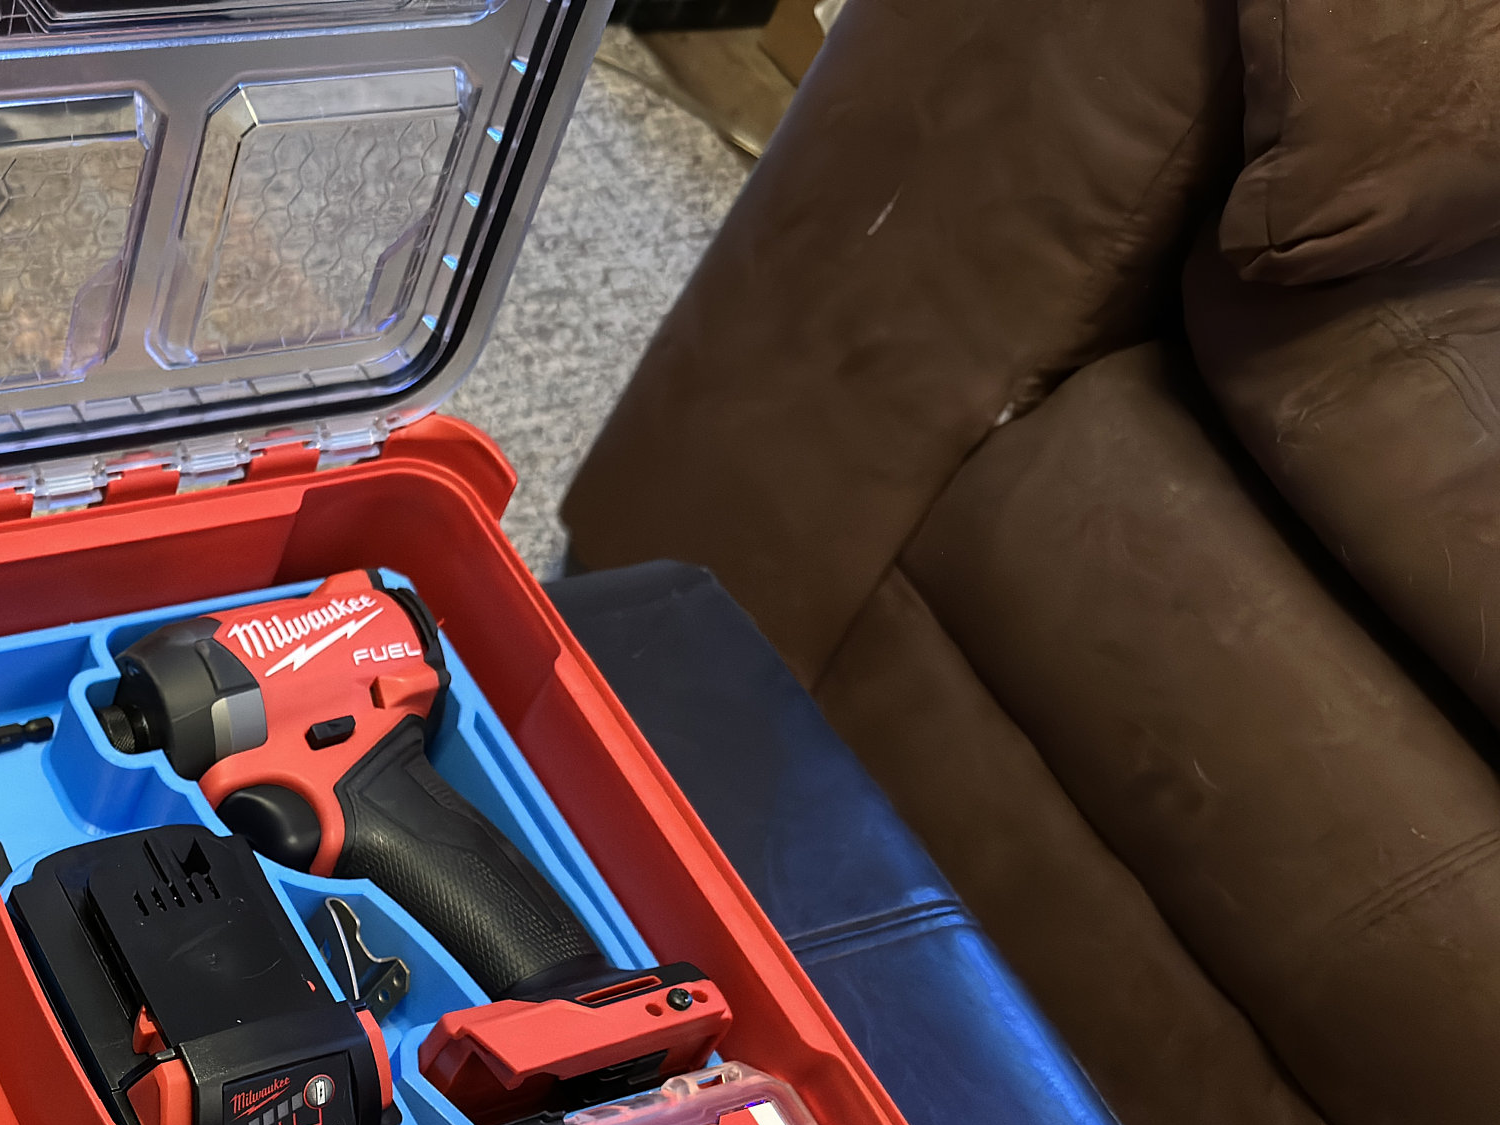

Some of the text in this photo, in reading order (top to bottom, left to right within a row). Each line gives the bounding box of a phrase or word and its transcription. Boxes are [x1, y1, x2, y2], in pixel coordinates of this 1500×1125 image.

[228, 595, 378, 658] Milwaukee
[353, 642, 421, 666] FUEL
[230, 1077, 290, 1114] Milwaukee
